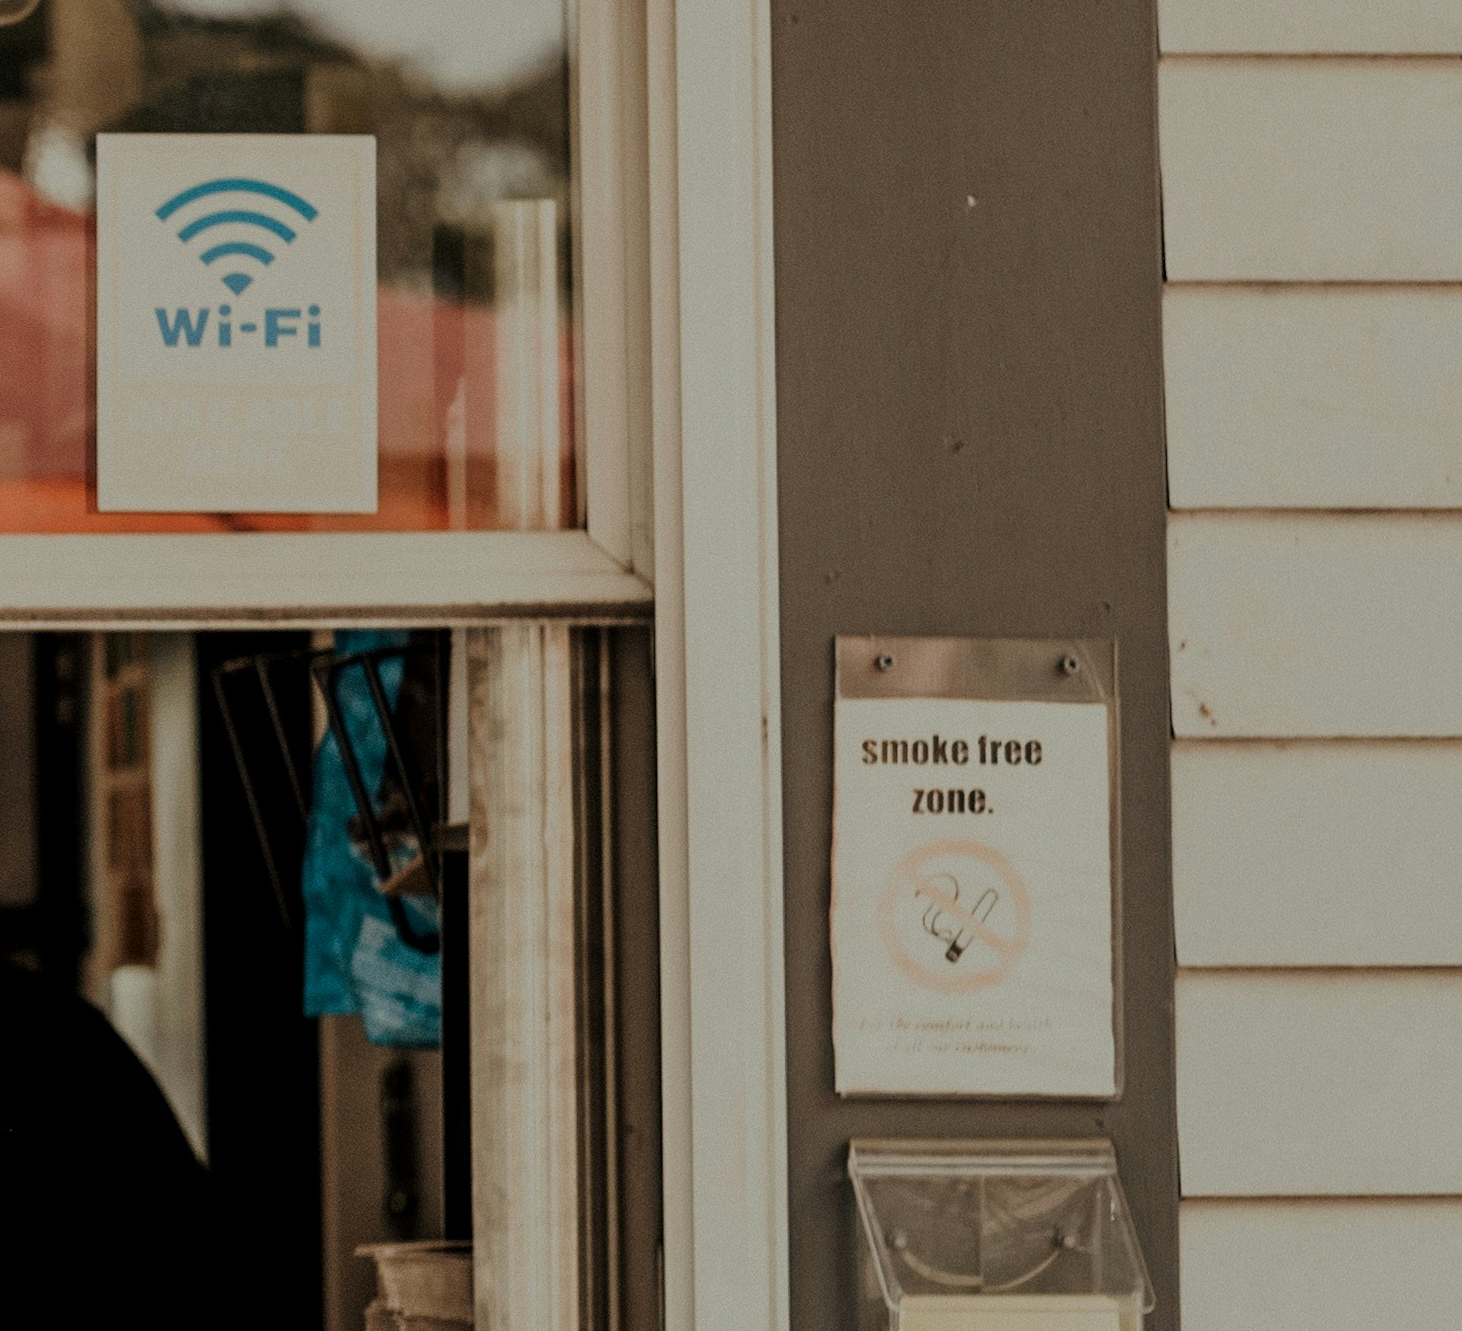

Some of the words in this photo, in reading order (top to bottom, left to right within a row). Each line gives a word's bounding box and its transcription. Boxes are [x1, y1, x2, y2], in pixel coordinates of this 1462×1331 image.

[154, 304, 322, 348] Wi-Fi
[861, 735, 969, 767] smoke
[978, 735, 1043, 767] free
[912, 786, 994, 815] zone.
